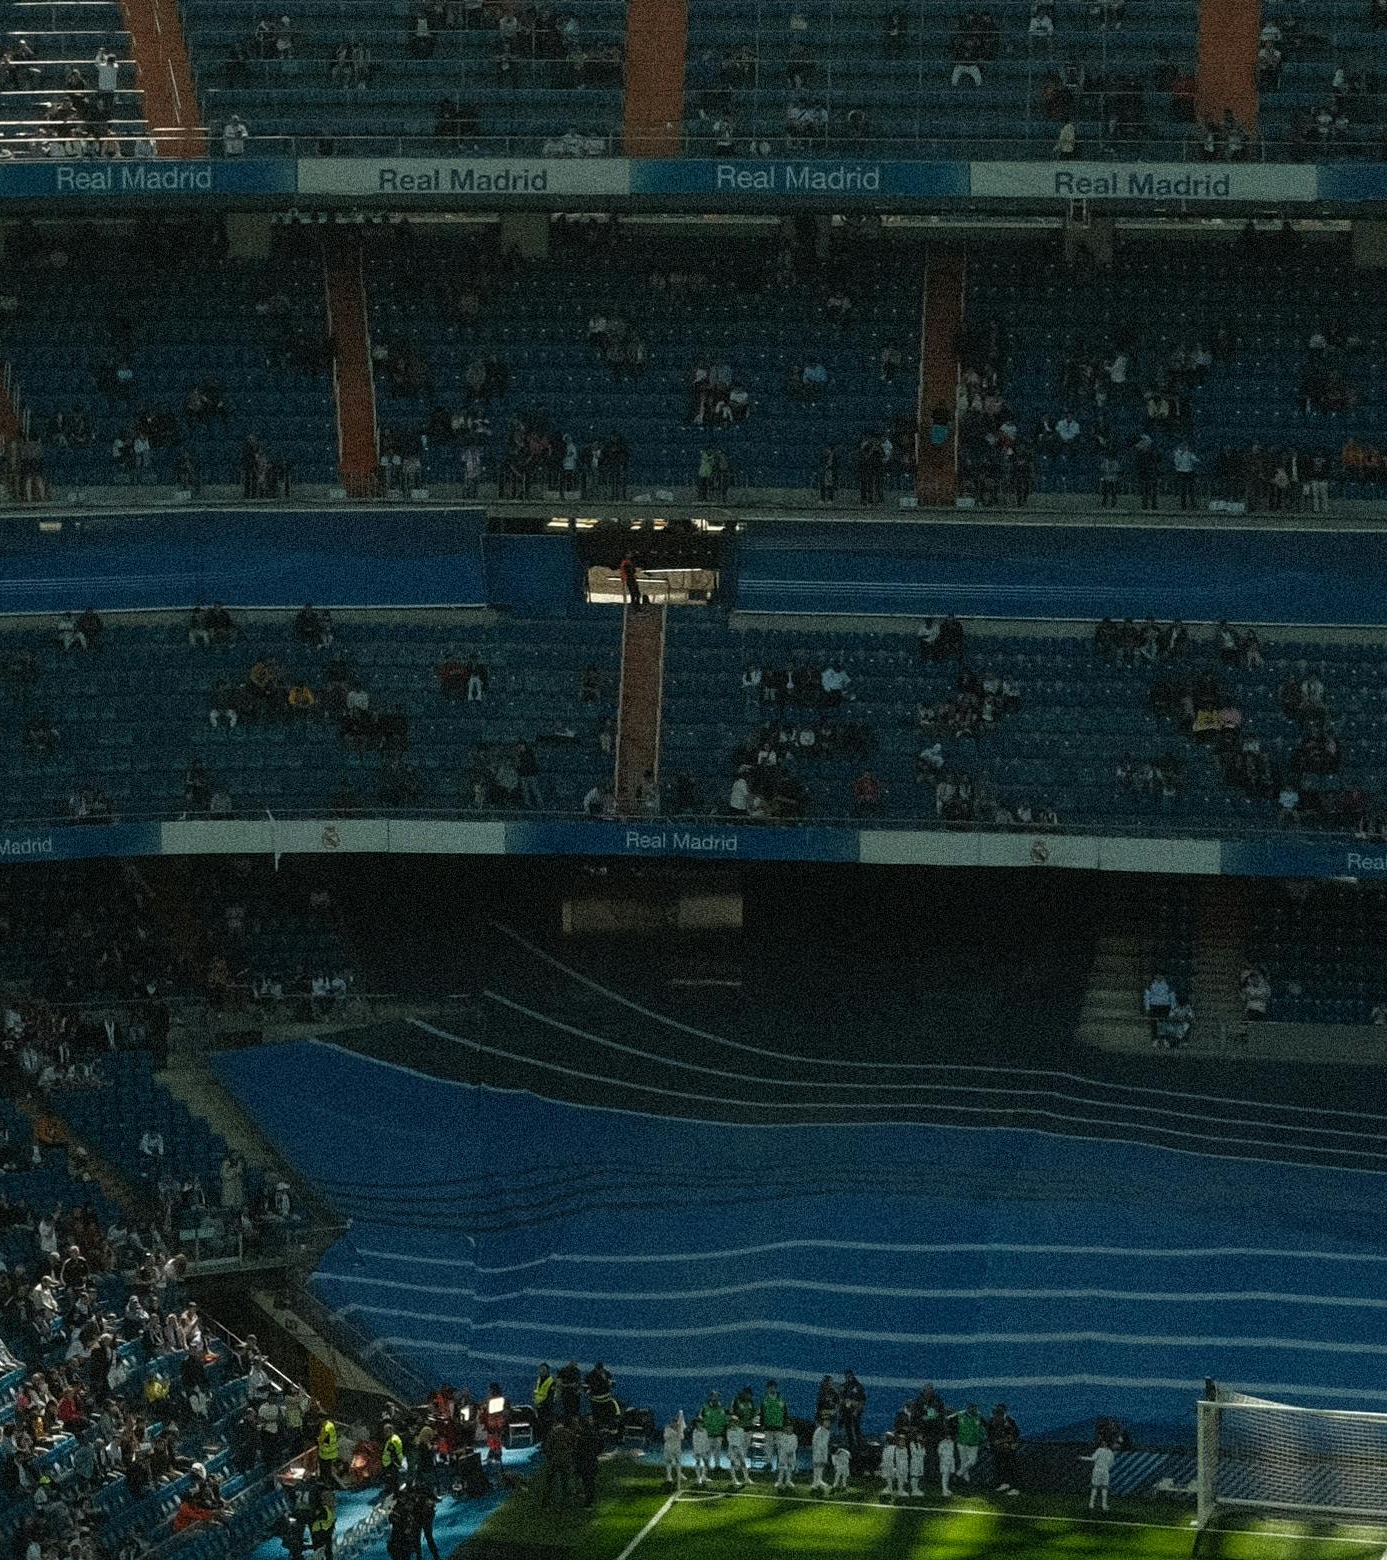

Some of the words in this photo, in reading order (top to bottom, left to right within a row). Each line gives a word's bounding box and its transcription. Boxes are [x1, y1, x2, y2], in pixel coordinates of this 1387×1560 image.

[57, 167, 111, 190] Real
[122, 166, 211, 189] Madrid
[379, 169, 439, 190] Real
[450, 168, 547, 190] Madrid
[717, 165, 775, 188] Real
[786, 166, 879, 190] Madrid
[1055, 172, 1117, 194] Real
[1129, 173, 1229, 196] Madrid
[626, 831, 667, 849] Real
[672, 832, 738, 852] Madrid
